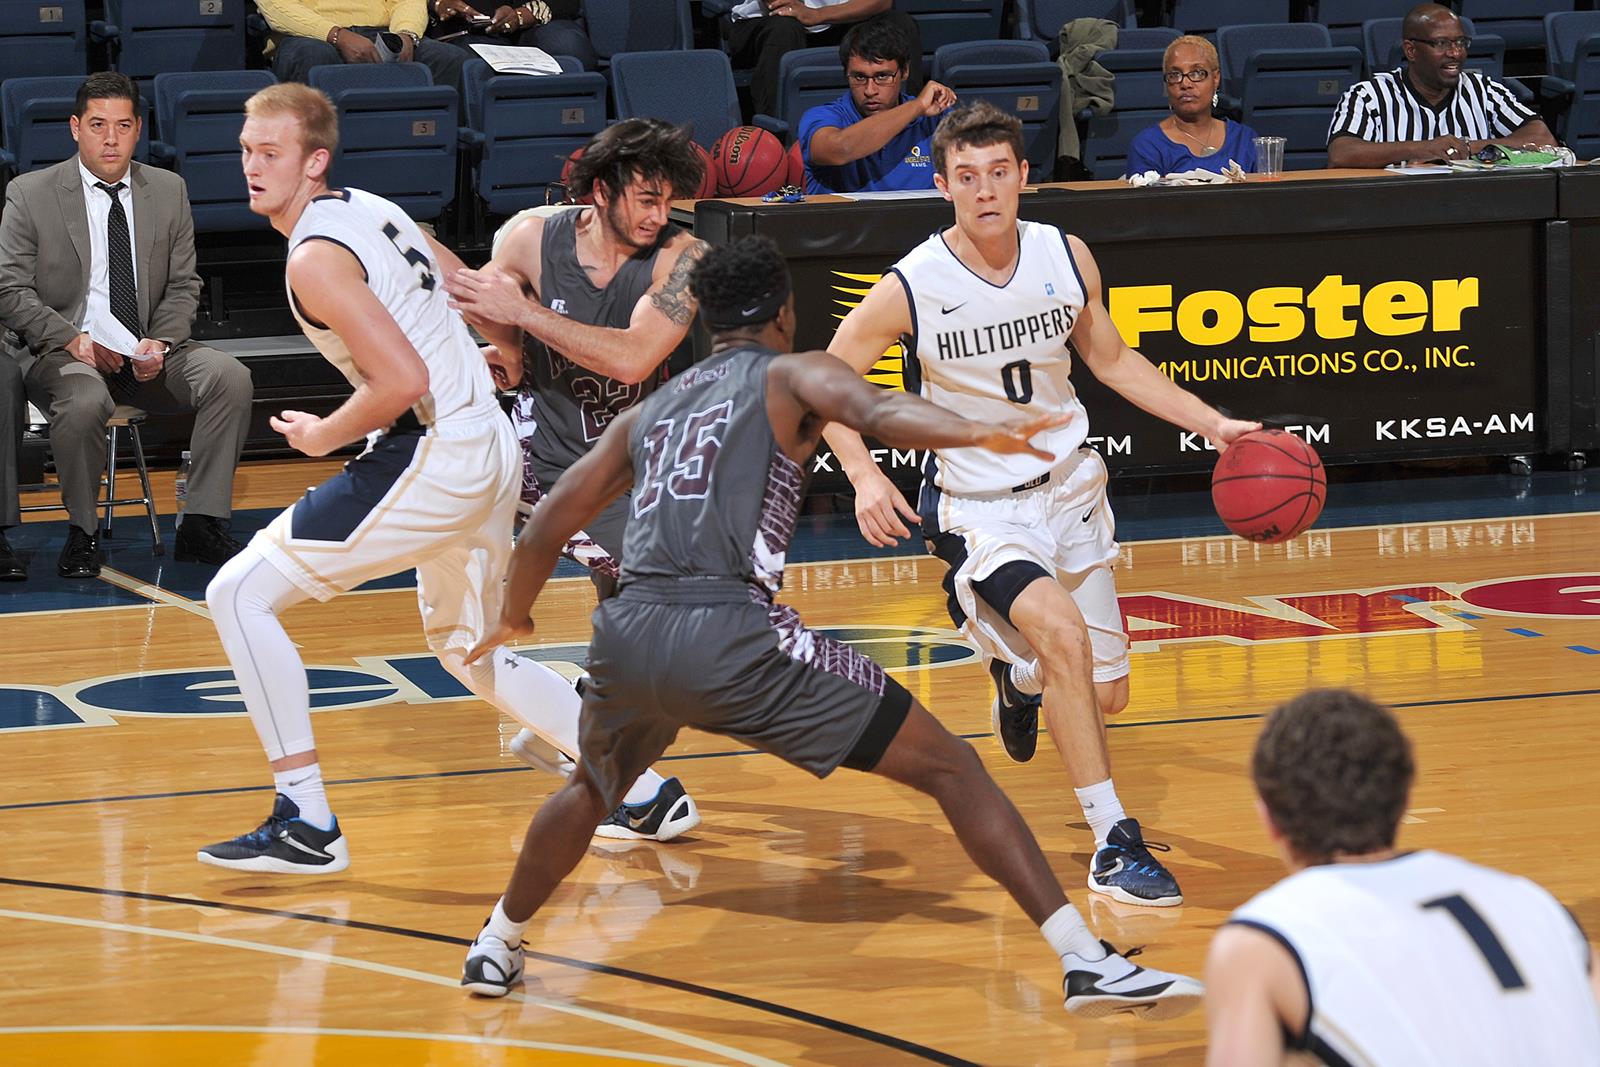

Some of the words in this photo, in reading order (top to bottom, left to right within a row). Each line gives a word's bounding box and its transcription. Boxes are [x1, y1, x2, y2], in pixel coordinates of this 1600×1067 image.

[381, 220, 436, 292] 5
[936, 305, 1075, 361] HILLTOPPERS
[1109, 275, 1479, 348] Foster
[1000, 358, 1033, 404] 0
[1157, 351, 1356, 383] MUNICATIONS
[1362, 348, 1418, 374] CO.,
[1424, 345, 1476, 369] INC.
[571, 376, 642, 443] 22
[1375, 411, 1534, 441] KKSA-AM
[634, 399, 734, 520] 15
[1418, 892, 1530, 991] 1
